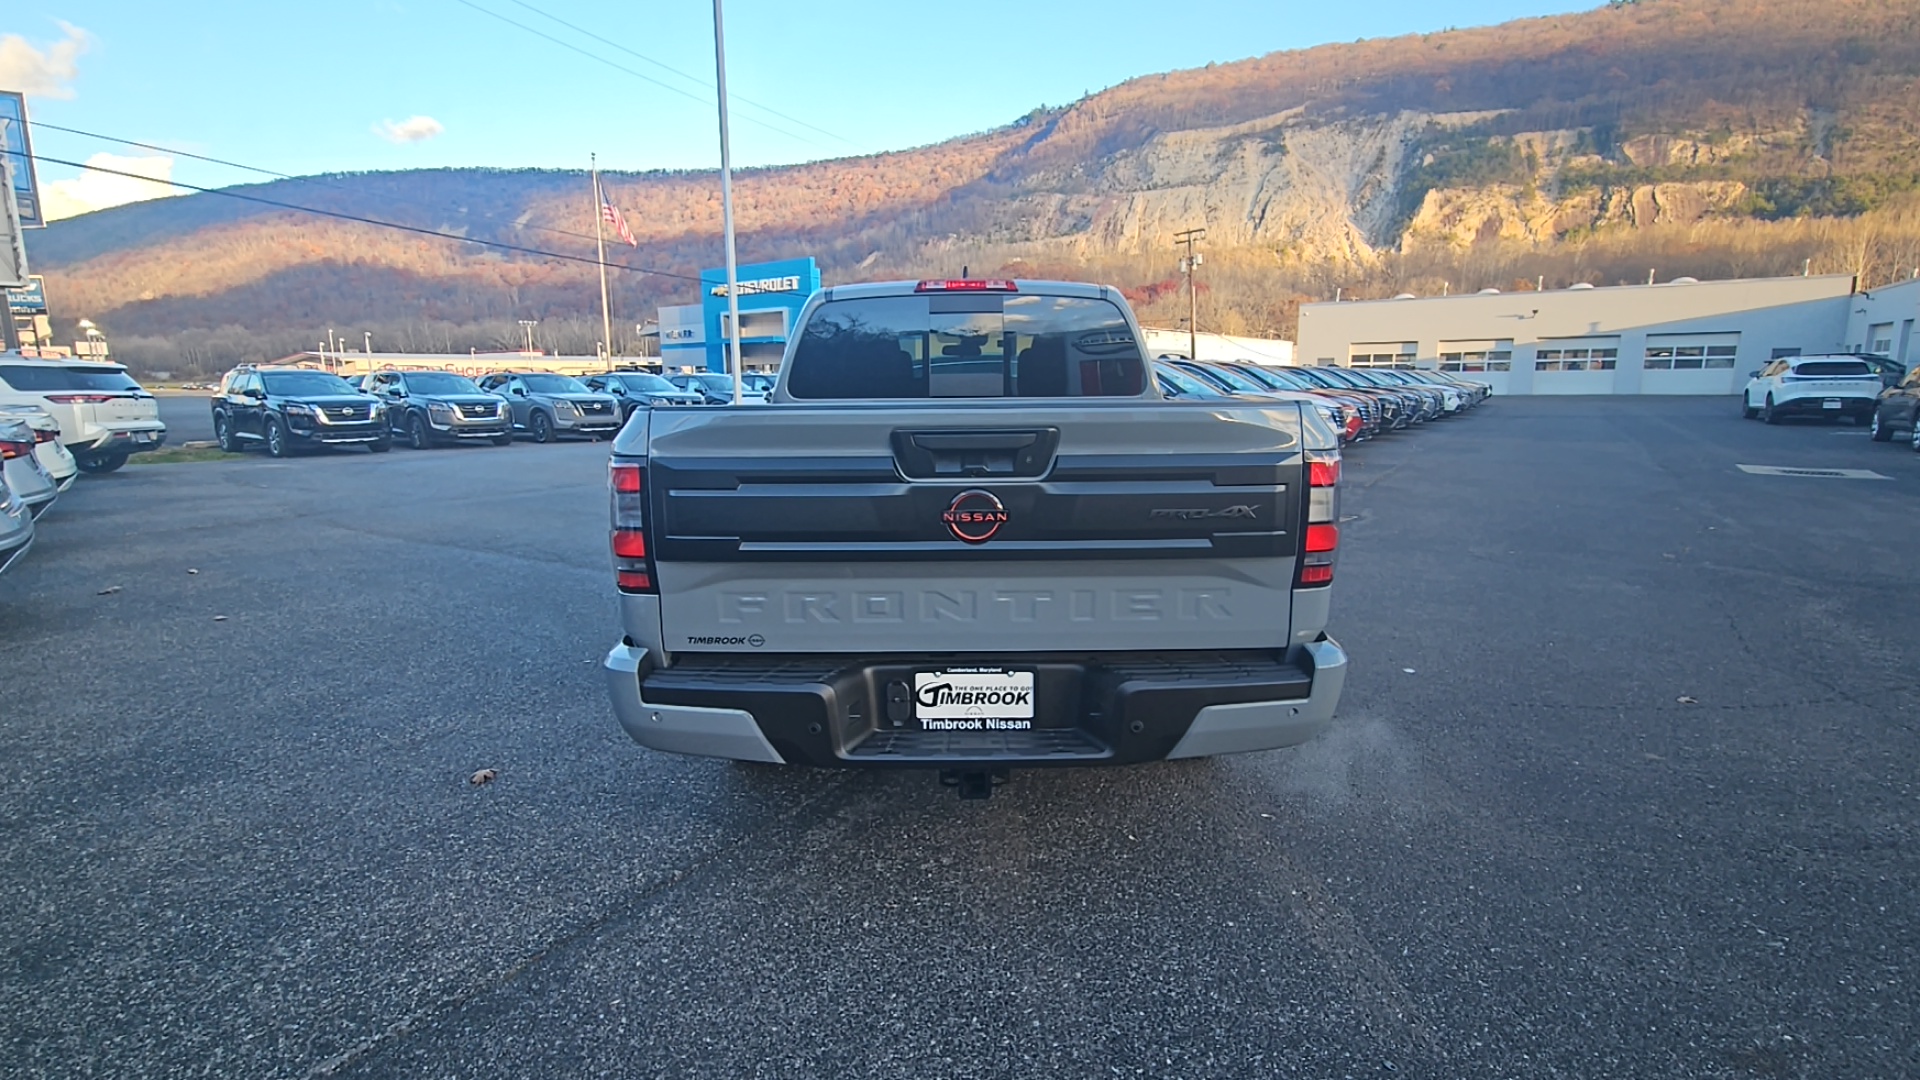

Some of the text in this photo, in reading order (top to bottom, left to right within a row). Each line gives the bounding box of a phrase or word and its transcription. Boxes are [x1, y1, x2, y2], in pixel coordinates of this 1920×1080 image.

[943, 512, 1007, 522] NISSAN
[716, 589, 1234, 624] FRONTIER
[686, 636, 746, 645] TIMBROOK
[916, 682, 1030, 707] TIMBROOK
[921, 718, 1031, 730] Timbrook Nissan
